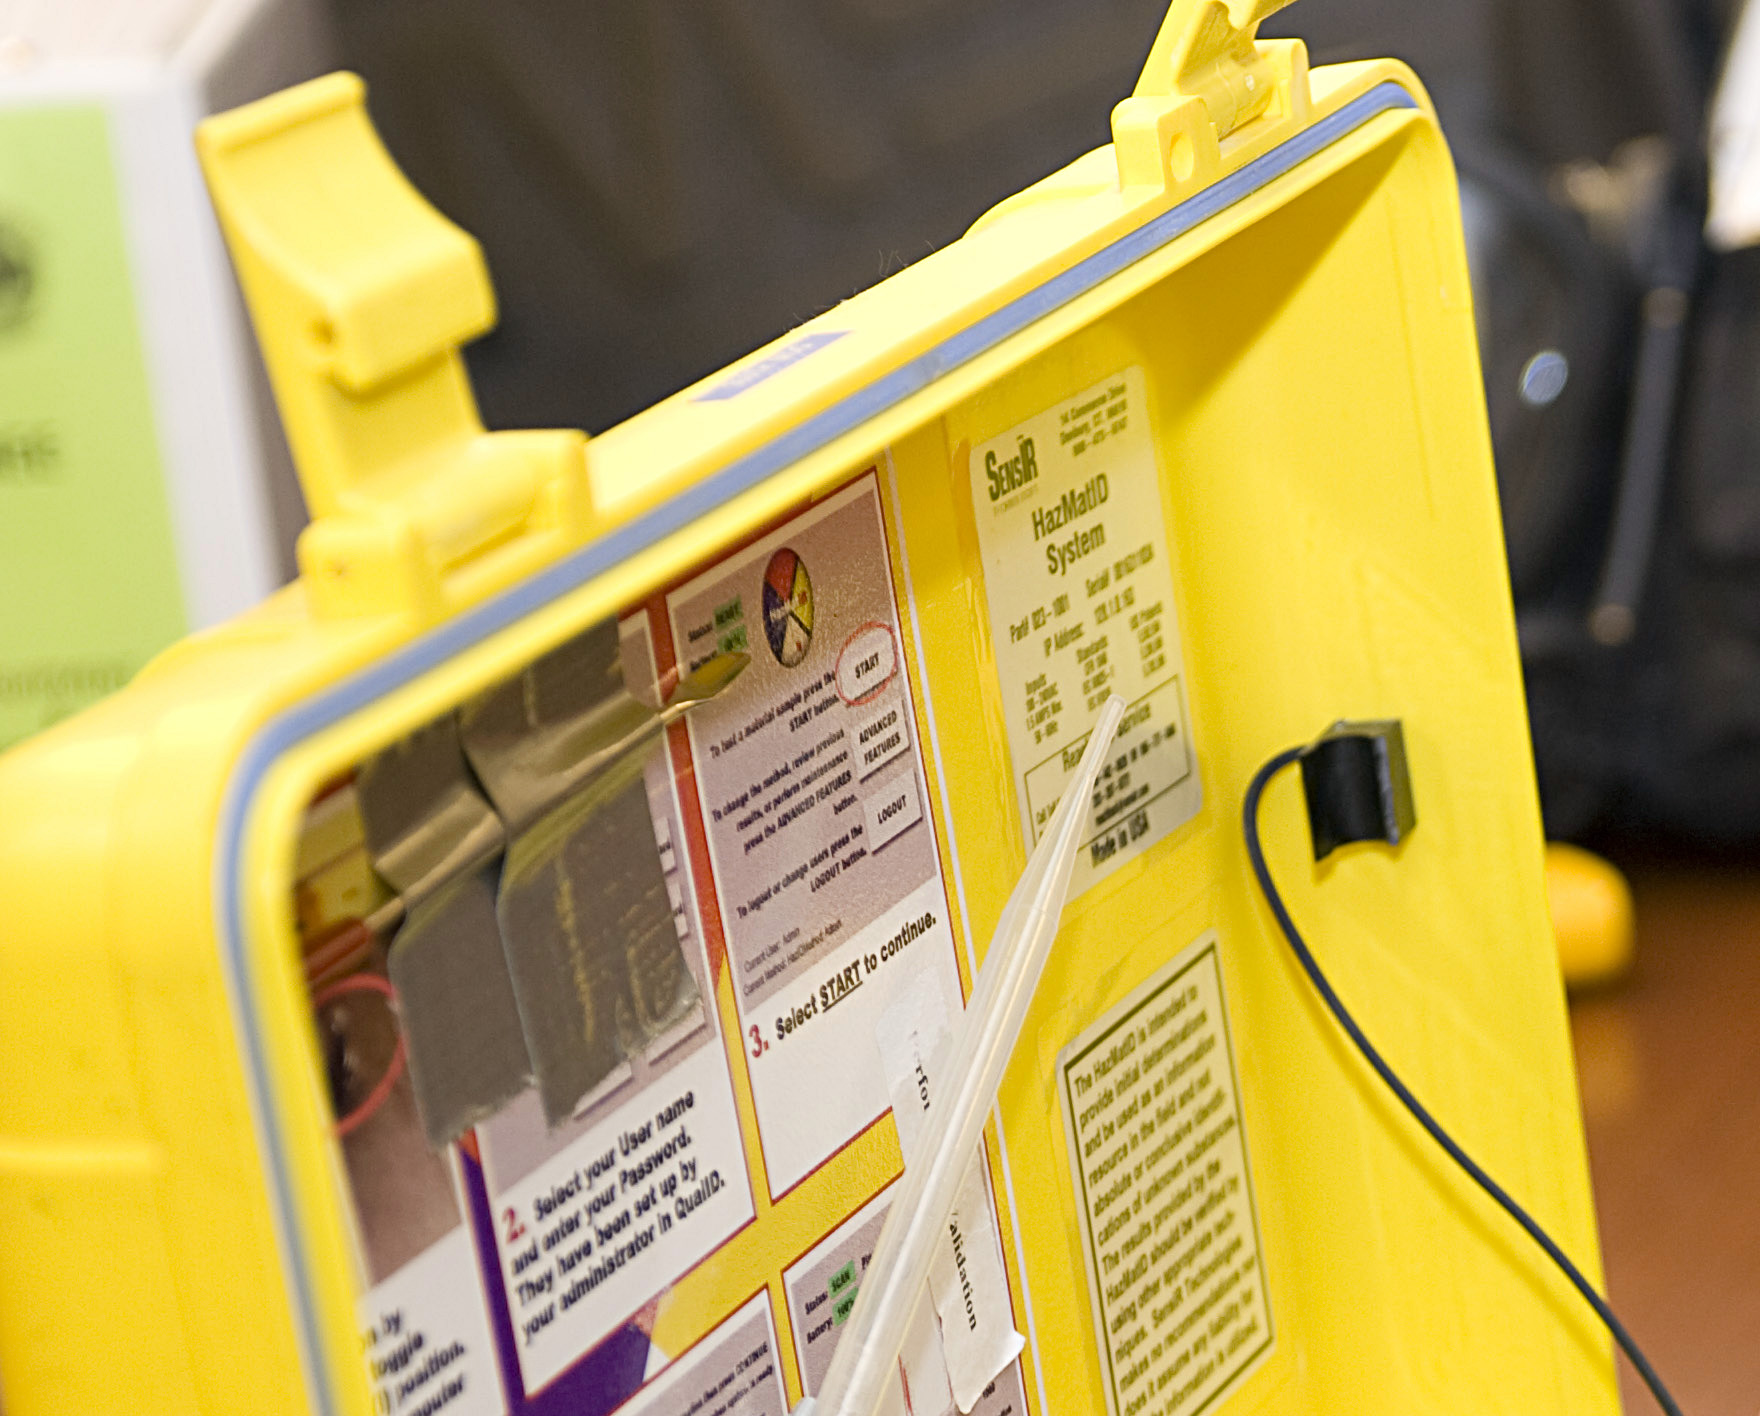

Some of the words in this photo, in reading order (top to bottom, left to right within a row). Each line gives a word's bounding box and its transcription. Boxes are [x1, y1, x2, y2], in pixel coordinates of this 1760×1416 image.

[1030, 472, 1109, 541] HazMatID
[1045, 522, 1106, 577] System
[854, 651, 879, 680] START
[858, 709, 898, 745] ADVANCED
[863, 730, 901, 765] FEATURES
[776, 794, 815, 830] ADVANCED
[814, 769, 852, 802] FEATURES
[876, 793, 906, 825] LOGOUT
[810, 860, 840, 893] LOGOUT
[747, 1023, 770, 1059] 3.
[775, 993, 819, 1040] Select
[818, 958, 861, 1008] START
[862, 952, 878, 974] to
[879, 911, 937, 962] continue.
[1073, 1072, 1093, 1098] The
[502, 1206, 526, 1243] 2.
[533, 1172, 582, 1222] Select
[583, 1147, 616, 1190] your
[618, 1120, 652, 1157] User
[654, 1090, 695, 1131] name
[510, 1239, 540, 1276] and
[541, 1209, 581, 1252] enter
[583, 1183, 616, 1226] your
[618, 1125, 692, 1193] Password.
[514, 1268, 554, 1305] They
[556, 1239, 593, 1276] have
[593, 1209, 631, 1247] been
[633, 1185, 657, 1218] set
[658, 1172, 677, 1198] up
[678, 1156, 697, 1182] by
[522, 1301, 555, 1346] your
[558, 1223, 655, 1312] administrator
[656, 1212, 673, 1234] in
[949, 1210, 977, 1332] alidation
